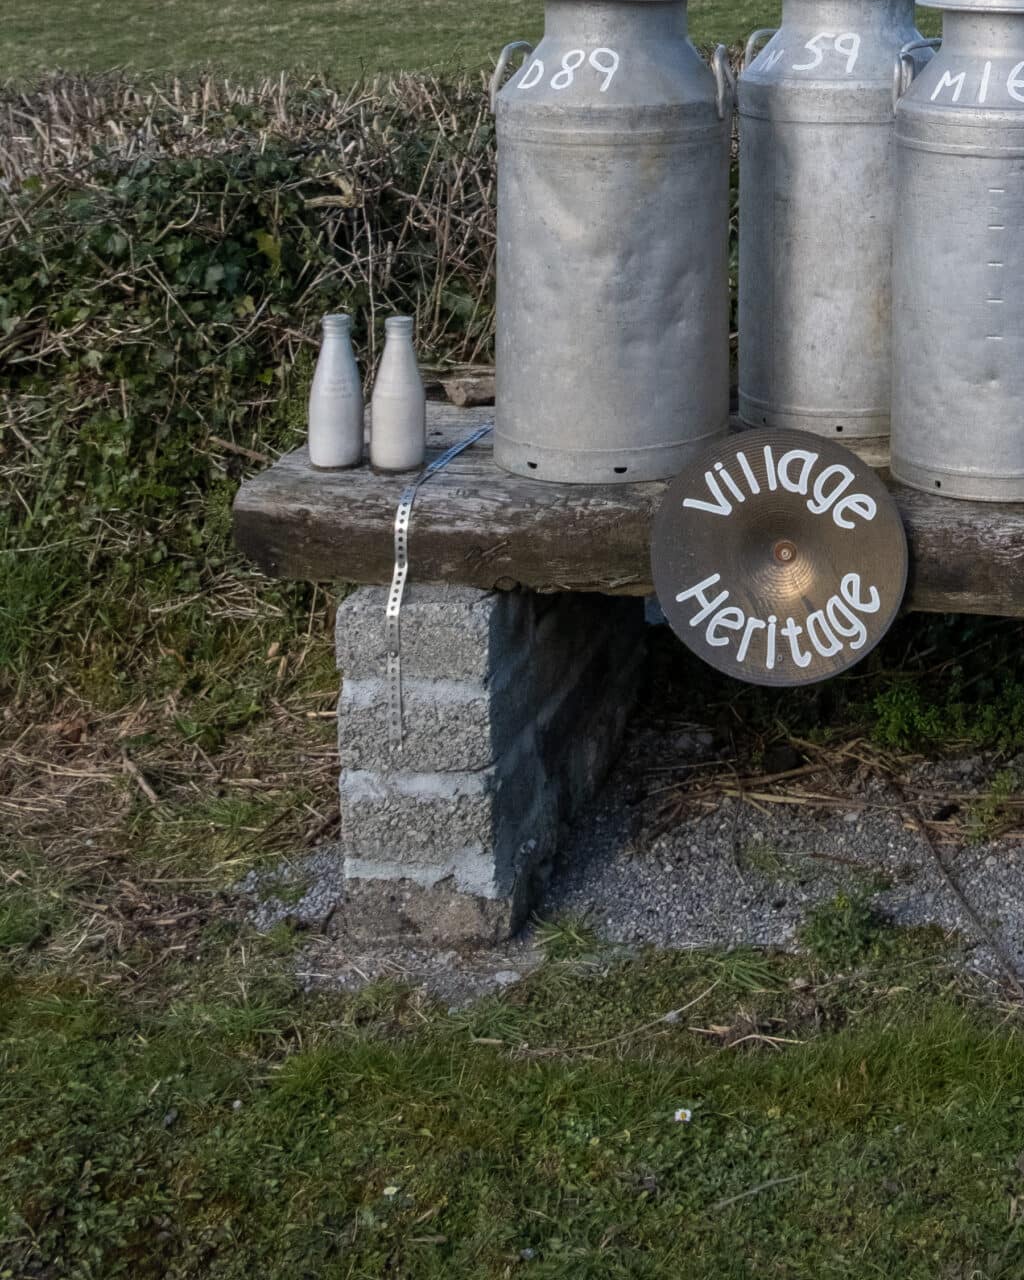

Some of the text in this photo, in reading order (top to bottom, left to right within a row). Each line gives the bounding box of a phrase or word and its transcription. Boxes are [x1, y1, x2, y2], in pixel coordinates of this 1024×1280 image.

[792, 32, 861, 74] 59
[683, 445, 877, 530] Village
[675, 572, 881, 670] Heritage
